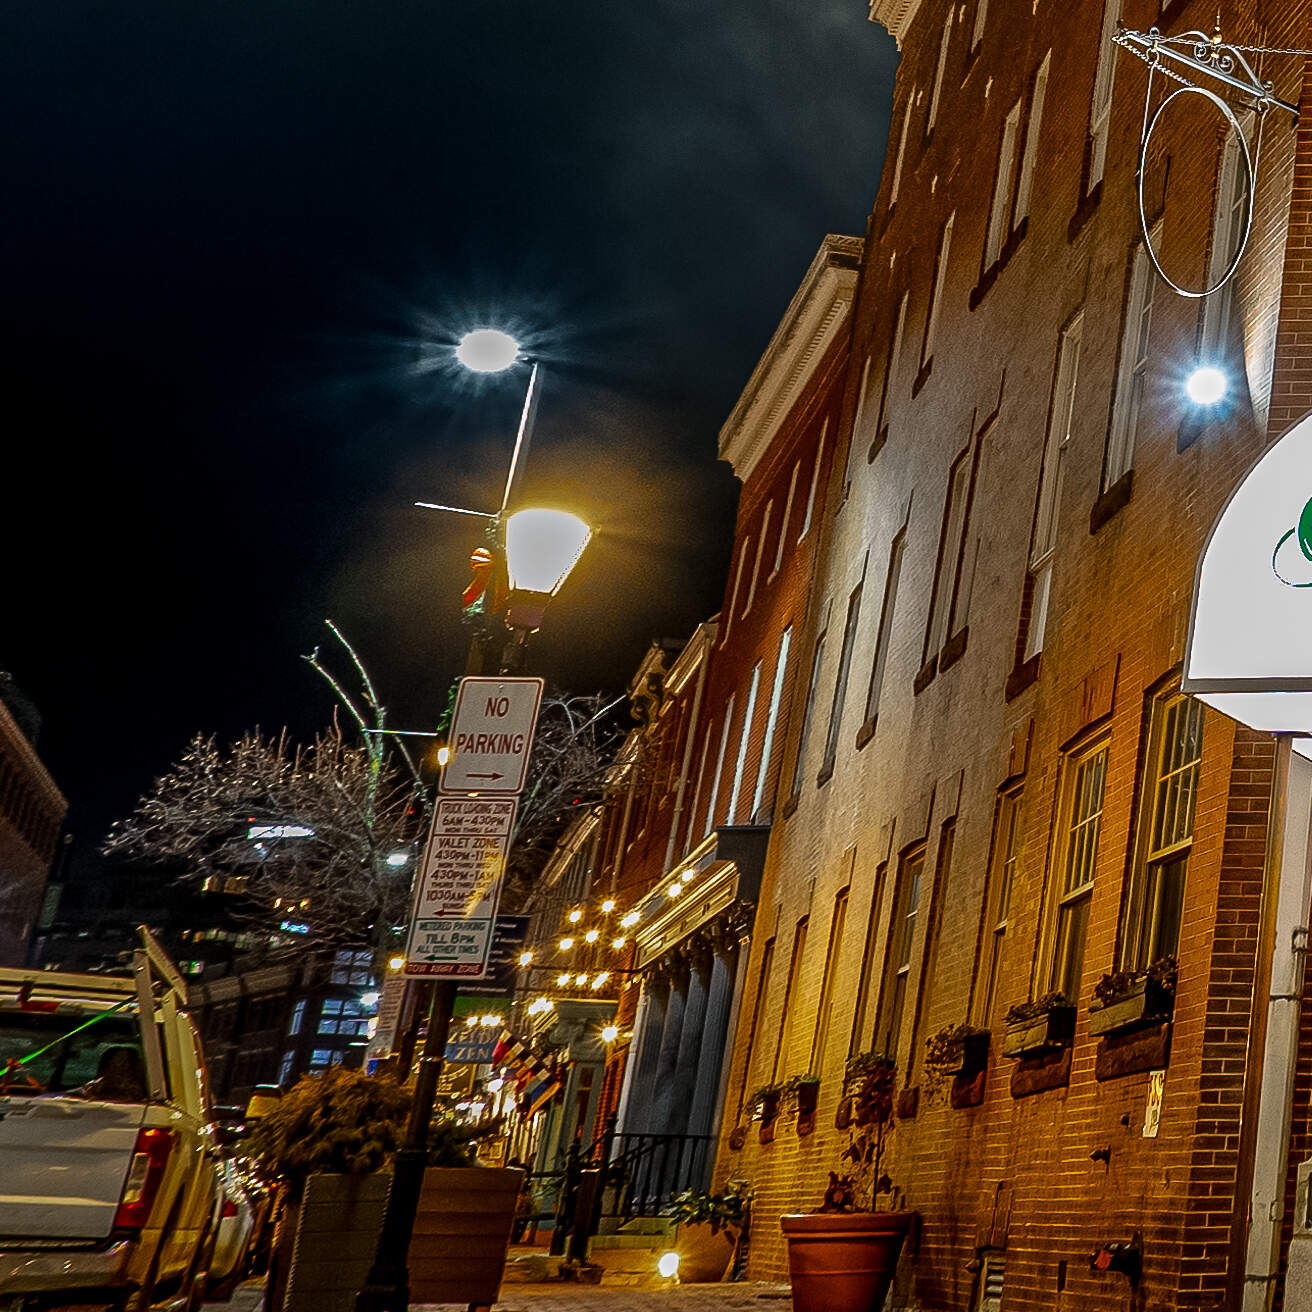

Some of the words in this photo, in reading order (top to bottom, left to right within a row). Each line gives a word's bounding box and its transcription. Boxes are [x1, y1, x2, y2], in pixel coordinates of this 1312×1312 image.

[484, 696, 510, 718] NO
[454, 733, 524, 755] PARKING
[438, 837, 471, 849] VALET
[472, 838, 501, 849] ZONE
[425, 934, 448, 944] TILL
[450, 932, 475, 944] 8PM
[415, 945, 431, 953] ALL
